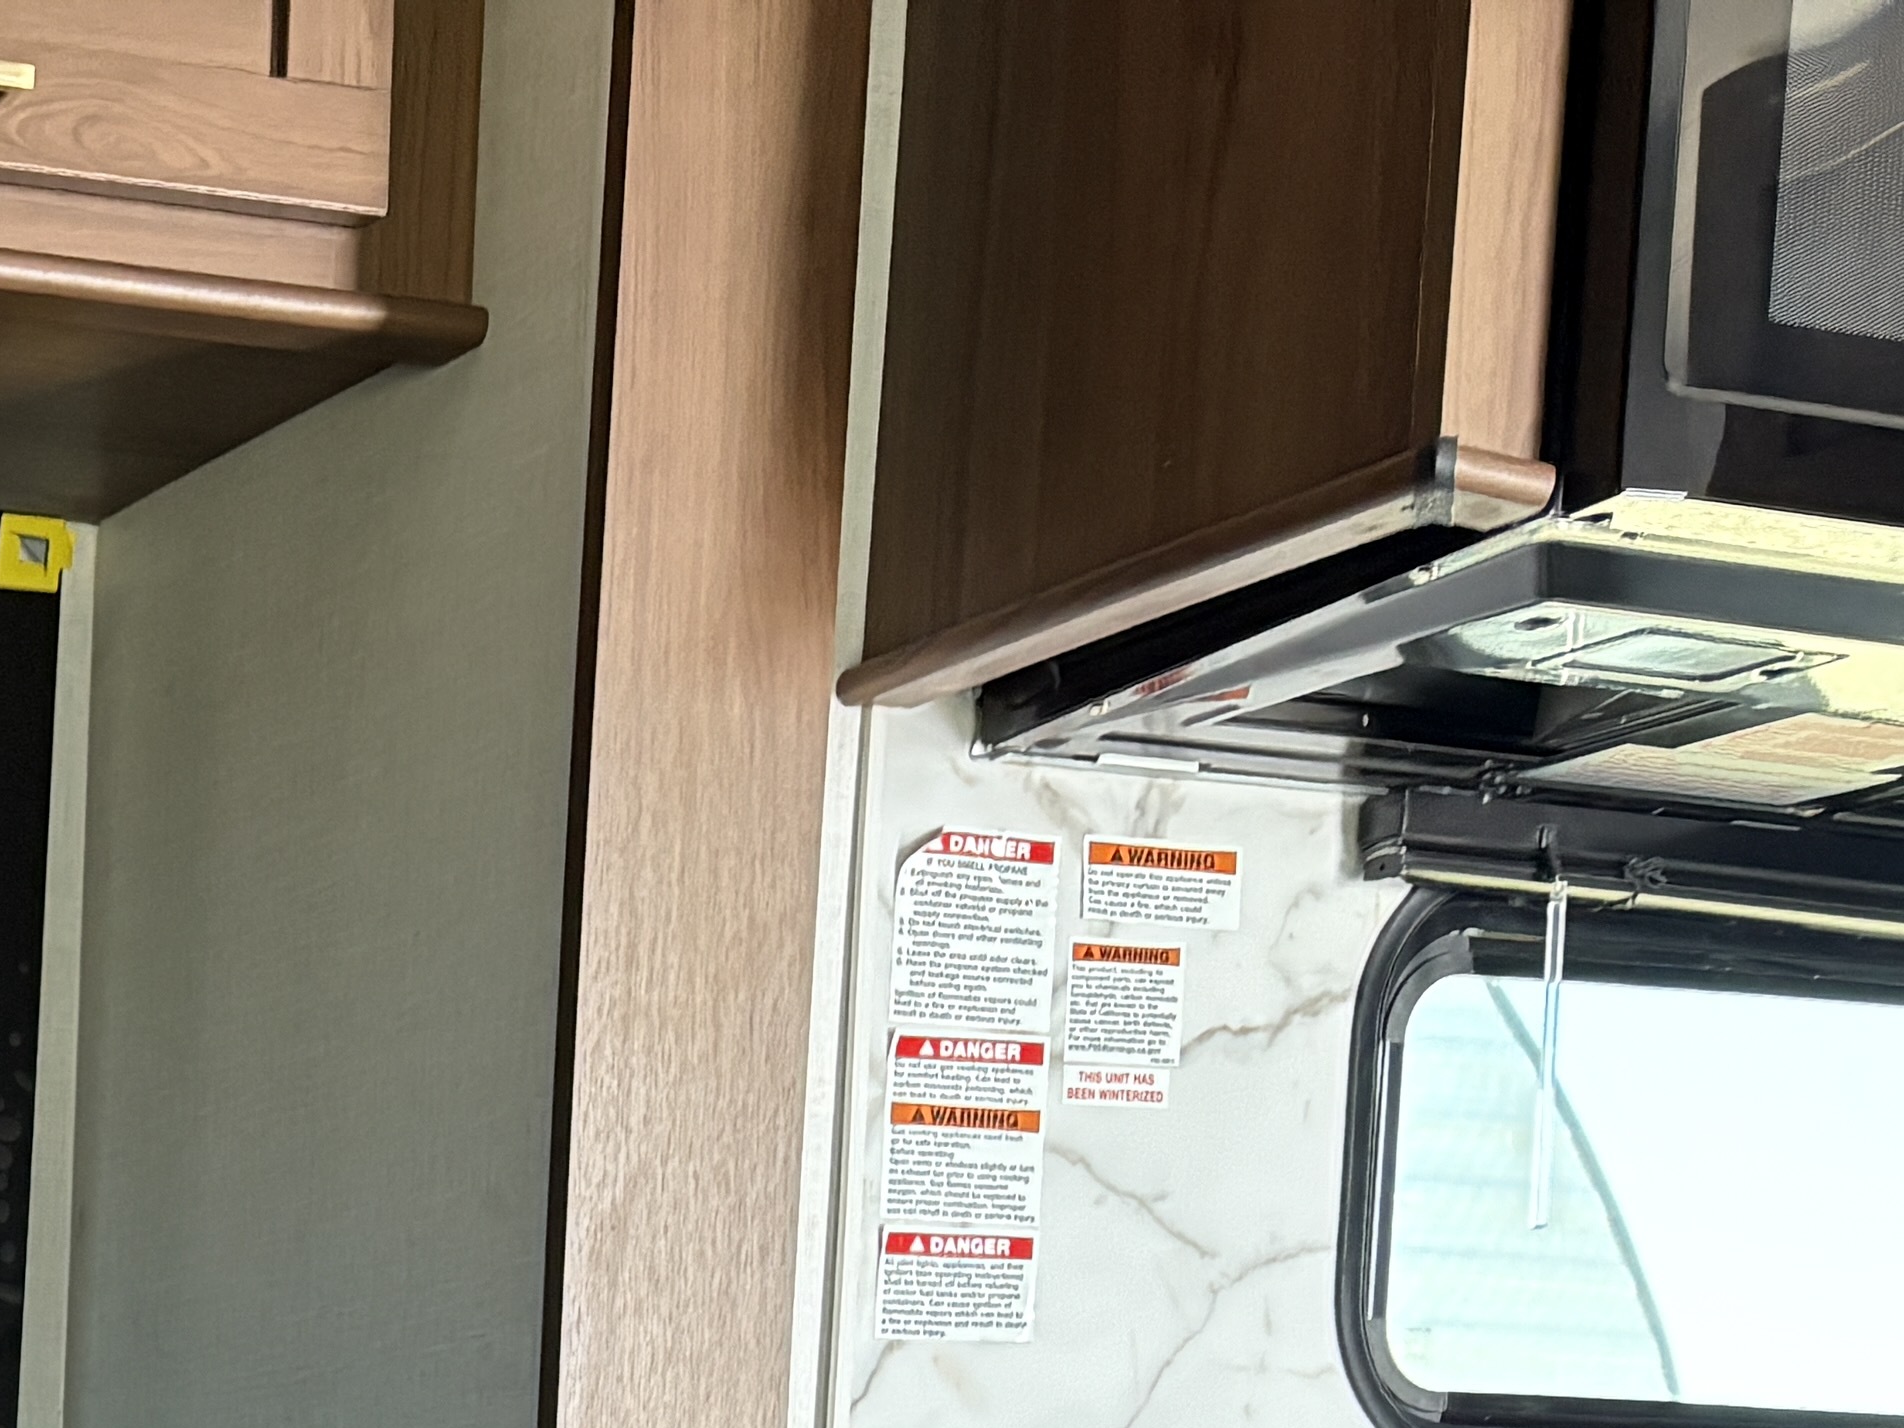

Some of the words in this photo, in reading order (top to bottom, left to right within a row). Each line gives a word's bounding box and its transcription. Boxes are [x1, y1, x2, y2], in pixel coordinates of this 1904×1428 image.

[950, 835, 1031, 860] DANGER
[1099, 945, 1169, 963] WARNING
[940, 1040, 1021, 1061] DANGER
[1079, 1071, 1102, 1083] THIS
[1106, 1073, 1129, 1084] UNIT
[1134, 1074, 1154, 1085] HAS
[1067, 1087, 1095, 1099] BEEN
[1099, 1088, 1163, 1102] WINTERIZED
[930, 1236, 1010, 1256] DANGER
